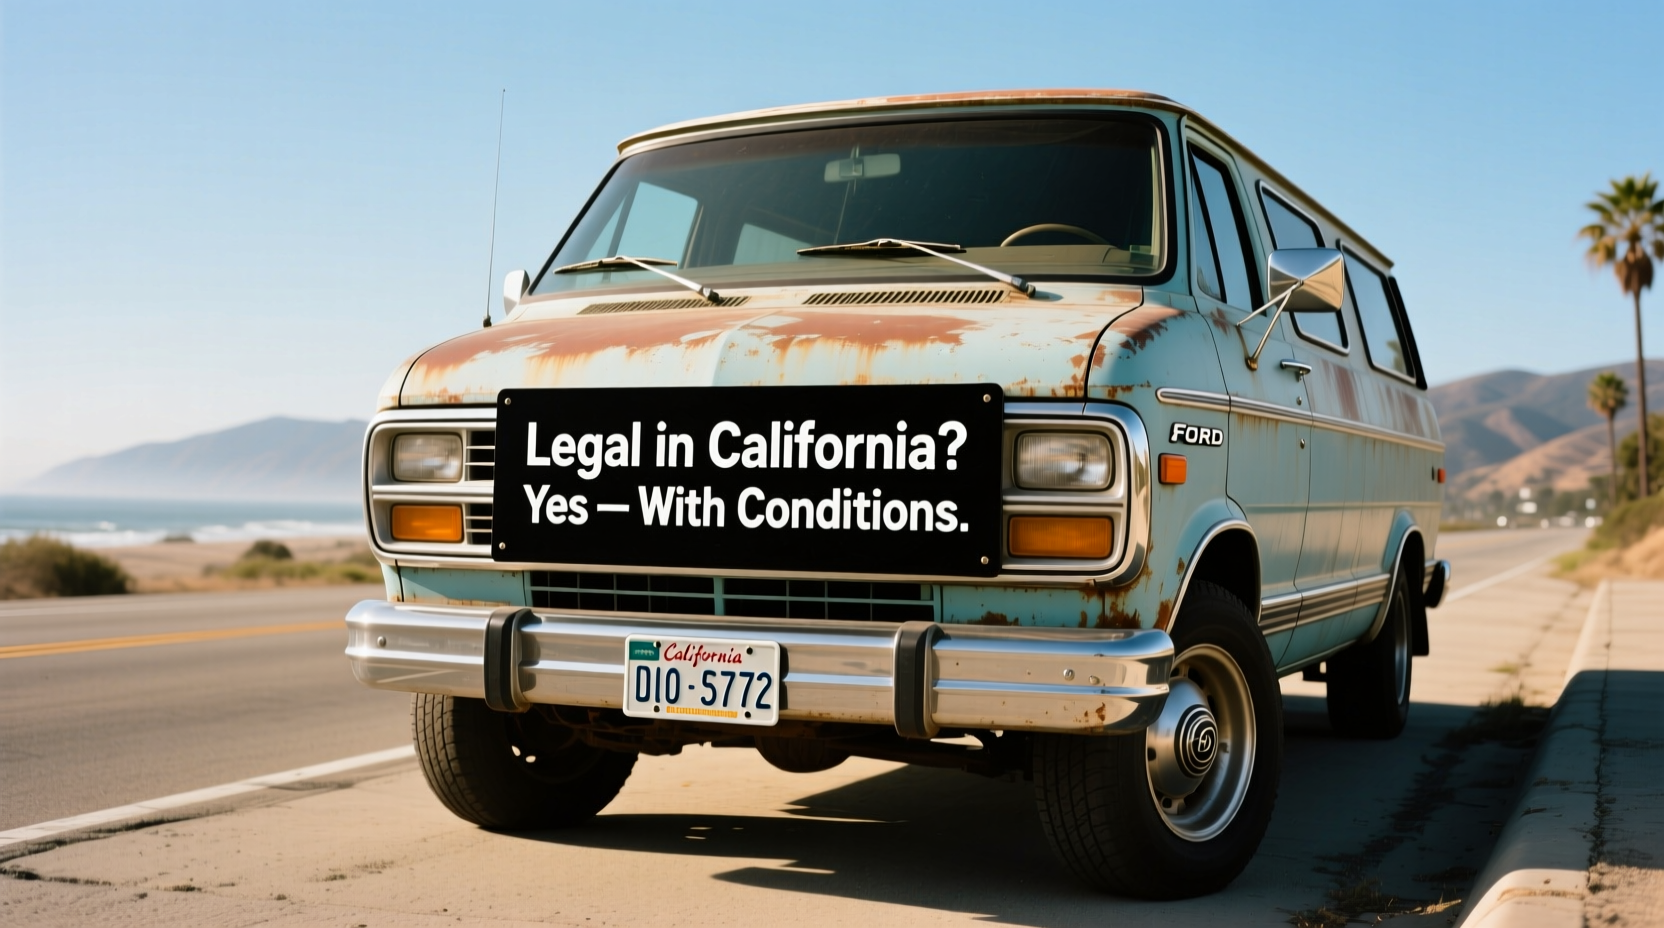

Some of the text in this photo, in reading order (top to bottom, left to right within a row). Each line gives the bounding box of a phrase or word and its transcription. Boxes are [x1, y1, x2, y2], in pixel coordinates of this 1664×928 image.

[526, 419, 968, 480] Legal in California?
[1170, 423, 1224, 446] FORD
[522, 483, 589, 526] Yes
[637, 485, 726, 528] With
[737, 486, 969, 533] Conditions.
[663, 642, 743, 668] California
